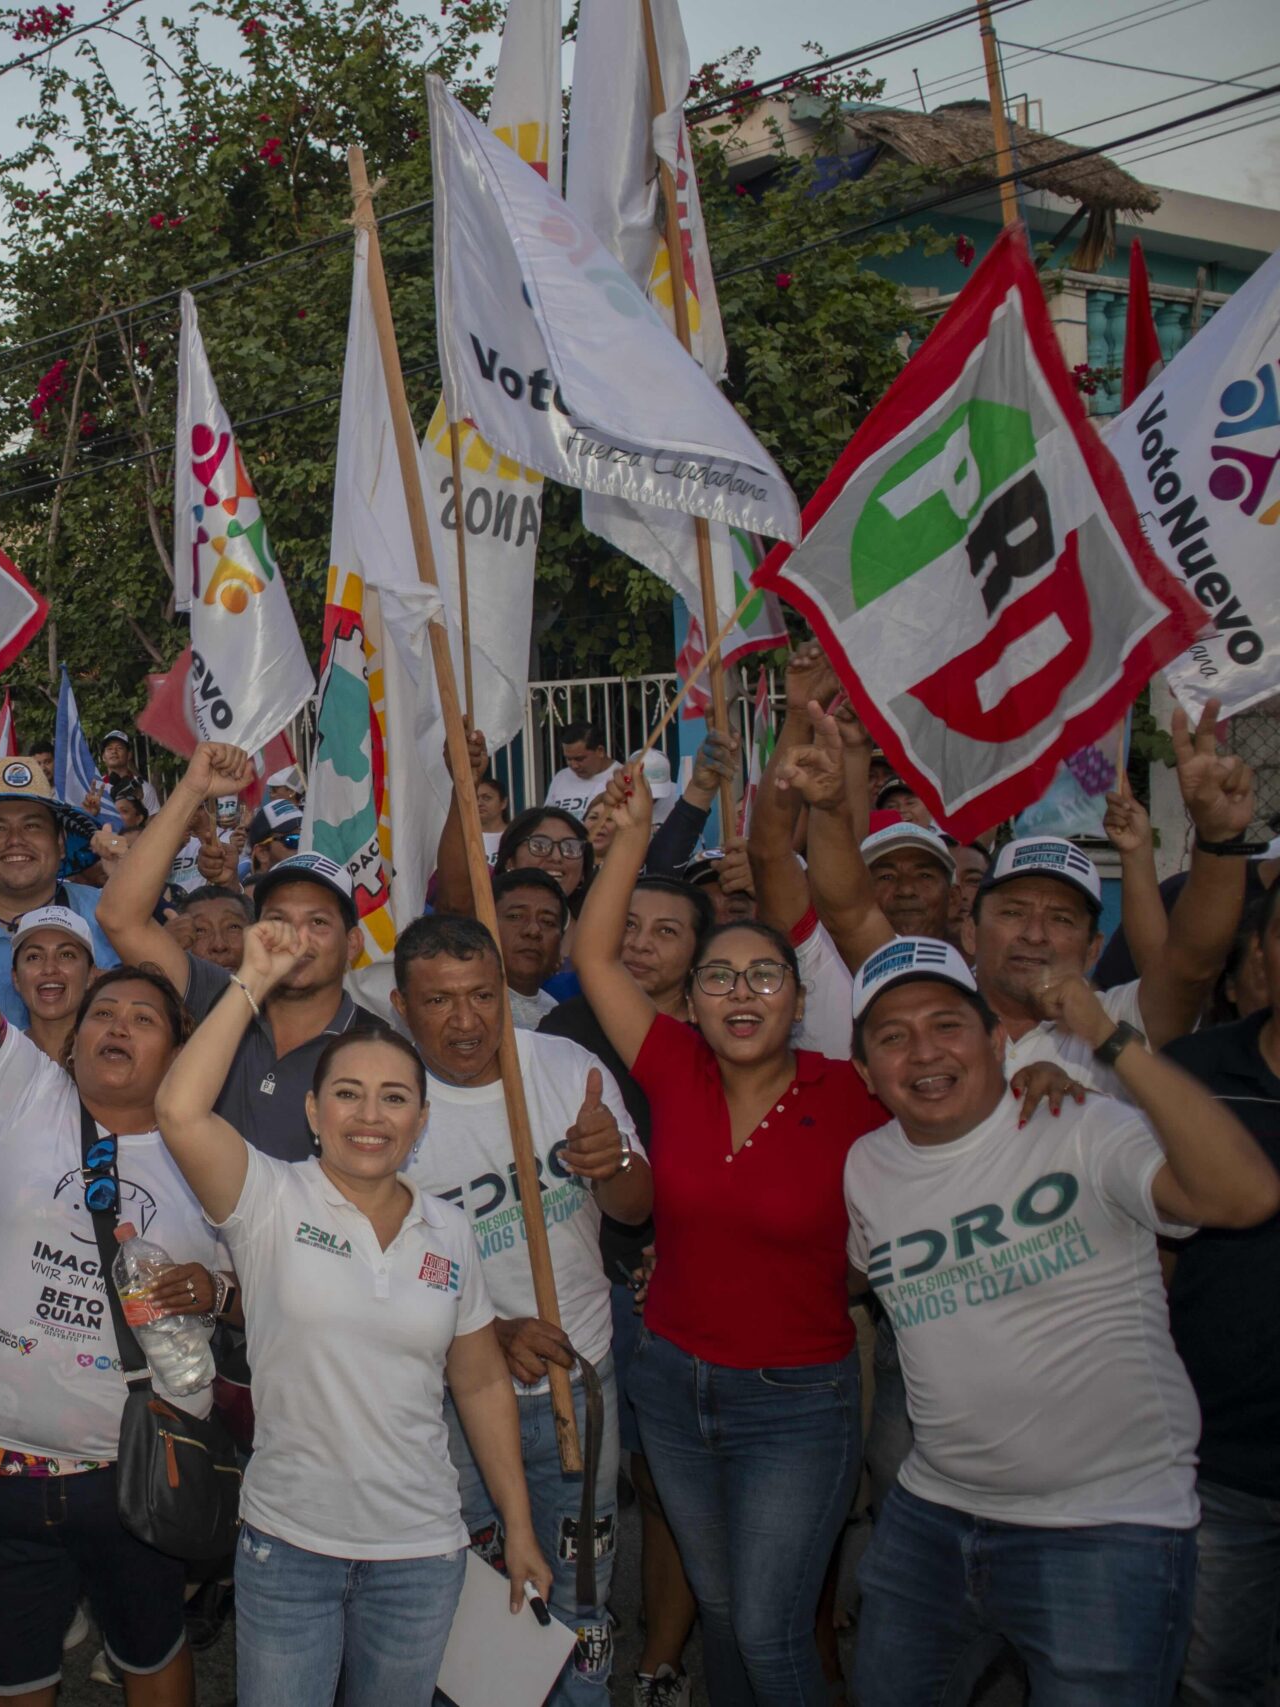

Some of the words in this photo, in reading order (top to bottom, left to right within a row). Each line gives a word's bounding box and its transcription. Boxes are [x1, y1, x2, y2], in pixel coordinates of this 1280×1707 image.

[566, 427, 642, 468] Fuerza
[654, 449, 769, 502] Ciudadana
[878, 413, 1072, 713] PRI
[472, 1206, 526, 1236] PRESIDEN
[296, 1222, 352, 1253] PERLA
[33, 1241, 105, 1279] IMAG
[424, 1253, 450, 1272] FUTURO
[899, 1256, 988, 1300] PRESIDENTE
[990, 1216, 1086, 1270] MUNICIPAL
[965, 1234, 1100, 1307] COZUMEL
[31, 1259, 61, 1281] VIVIR
[68, 1273, 89, 1288] SIN
[421, 1267, 449, 1285] SEGURO
[40, 1286, 105, 1315] BETO
[29, 1319, 66, 1334] DIPUTADO
[67, 1329, 102, 1342] FEDERAL
[36, 1303, 102, 1330] QUIAN
[44, 1328, 79, 1343] DISTRITO
